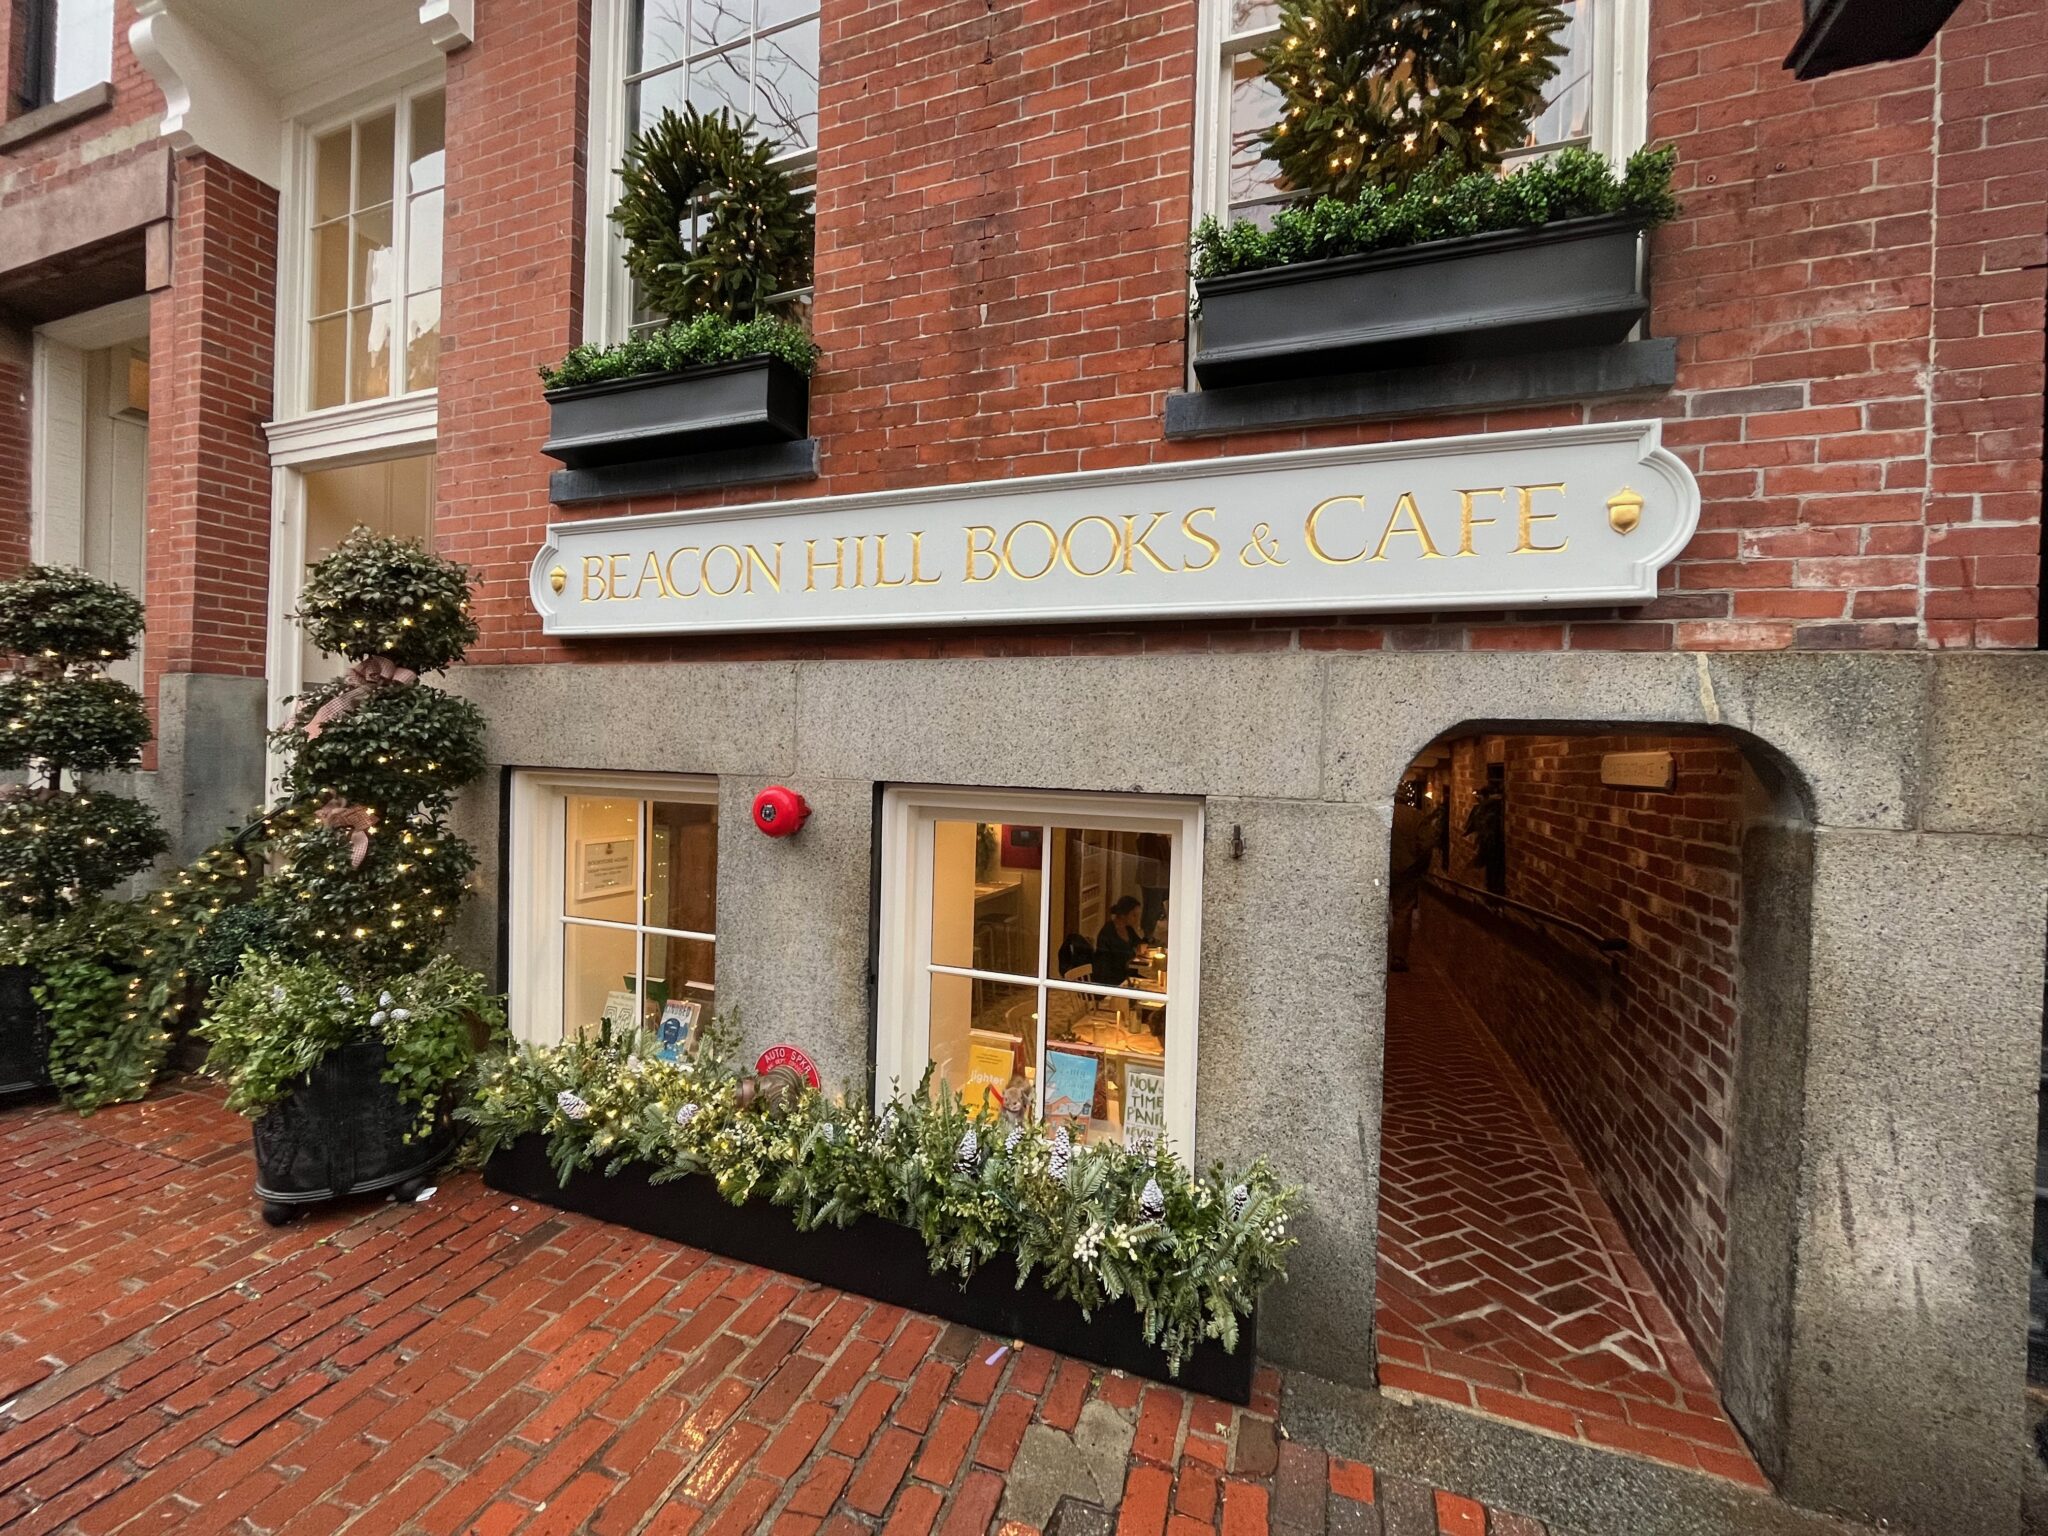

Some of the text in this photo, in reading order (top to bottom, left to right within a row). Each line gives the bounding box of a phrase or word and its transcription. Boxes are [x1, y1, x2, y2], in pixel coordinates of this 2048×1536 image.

[580, 482, 1569, 603] BEACON HILL BOOKS & CAFE
[764, 1048, 786, 1063] AUTO
[790, 1051, 812, 1074] SPKR
[971, 1069, 1004, 1086] lighter
[1130, 1074, 1159, 1093] NOW
[1132, 1095, 1164, 1110] TIME
